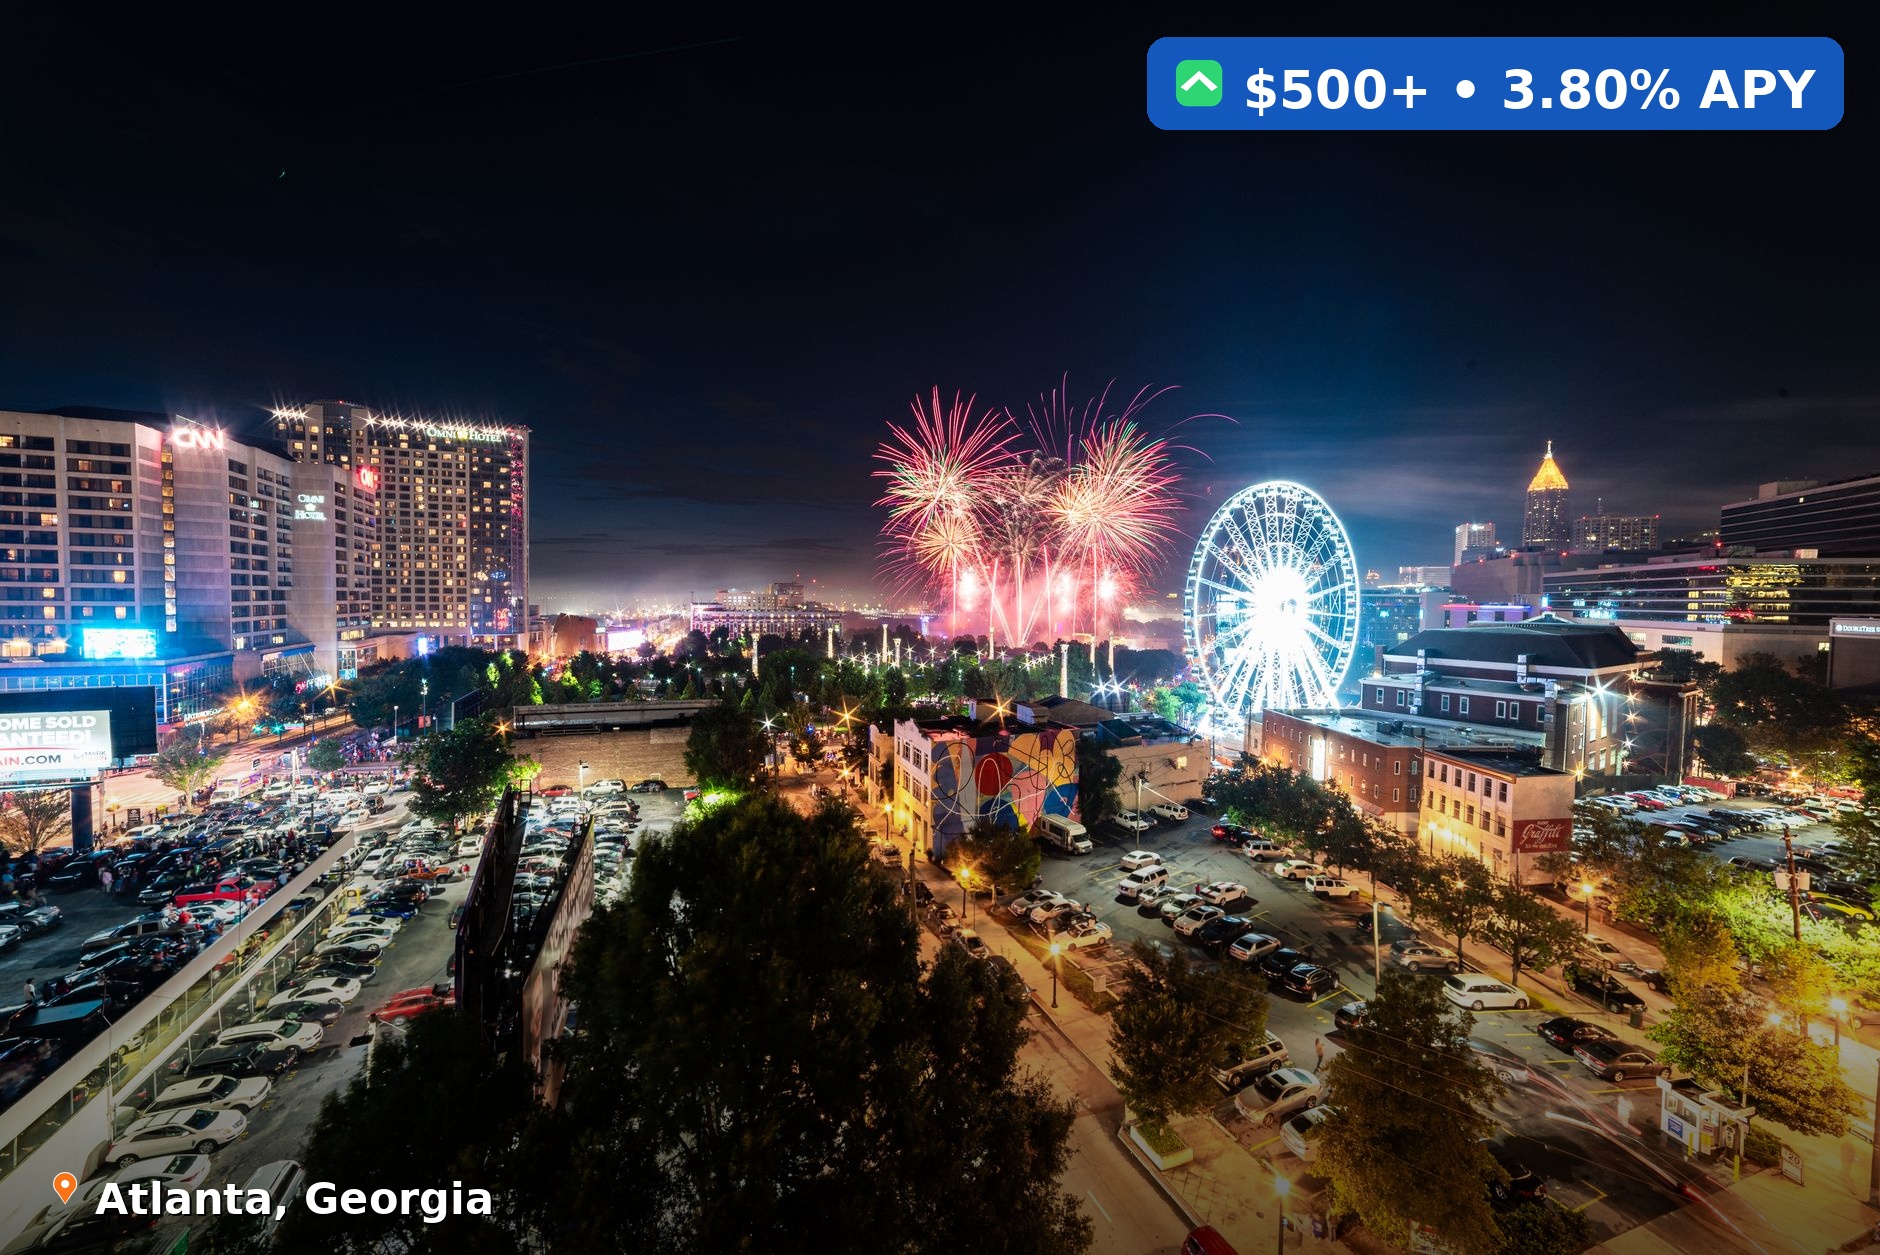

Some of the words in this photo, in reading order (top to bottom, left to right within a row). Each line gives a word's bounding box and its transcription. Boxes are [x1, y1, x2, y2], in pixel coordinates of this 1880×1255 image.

[171, 427, 224, 450] CNN
[426, 427, 456, 439] OMNI
[469, 430, 502, 442] HOTEL
[297, 493, 325, 504] OMNI
[294, 509, 327, 520] HOTEL
[45, 715, 97, 729] SOLD
